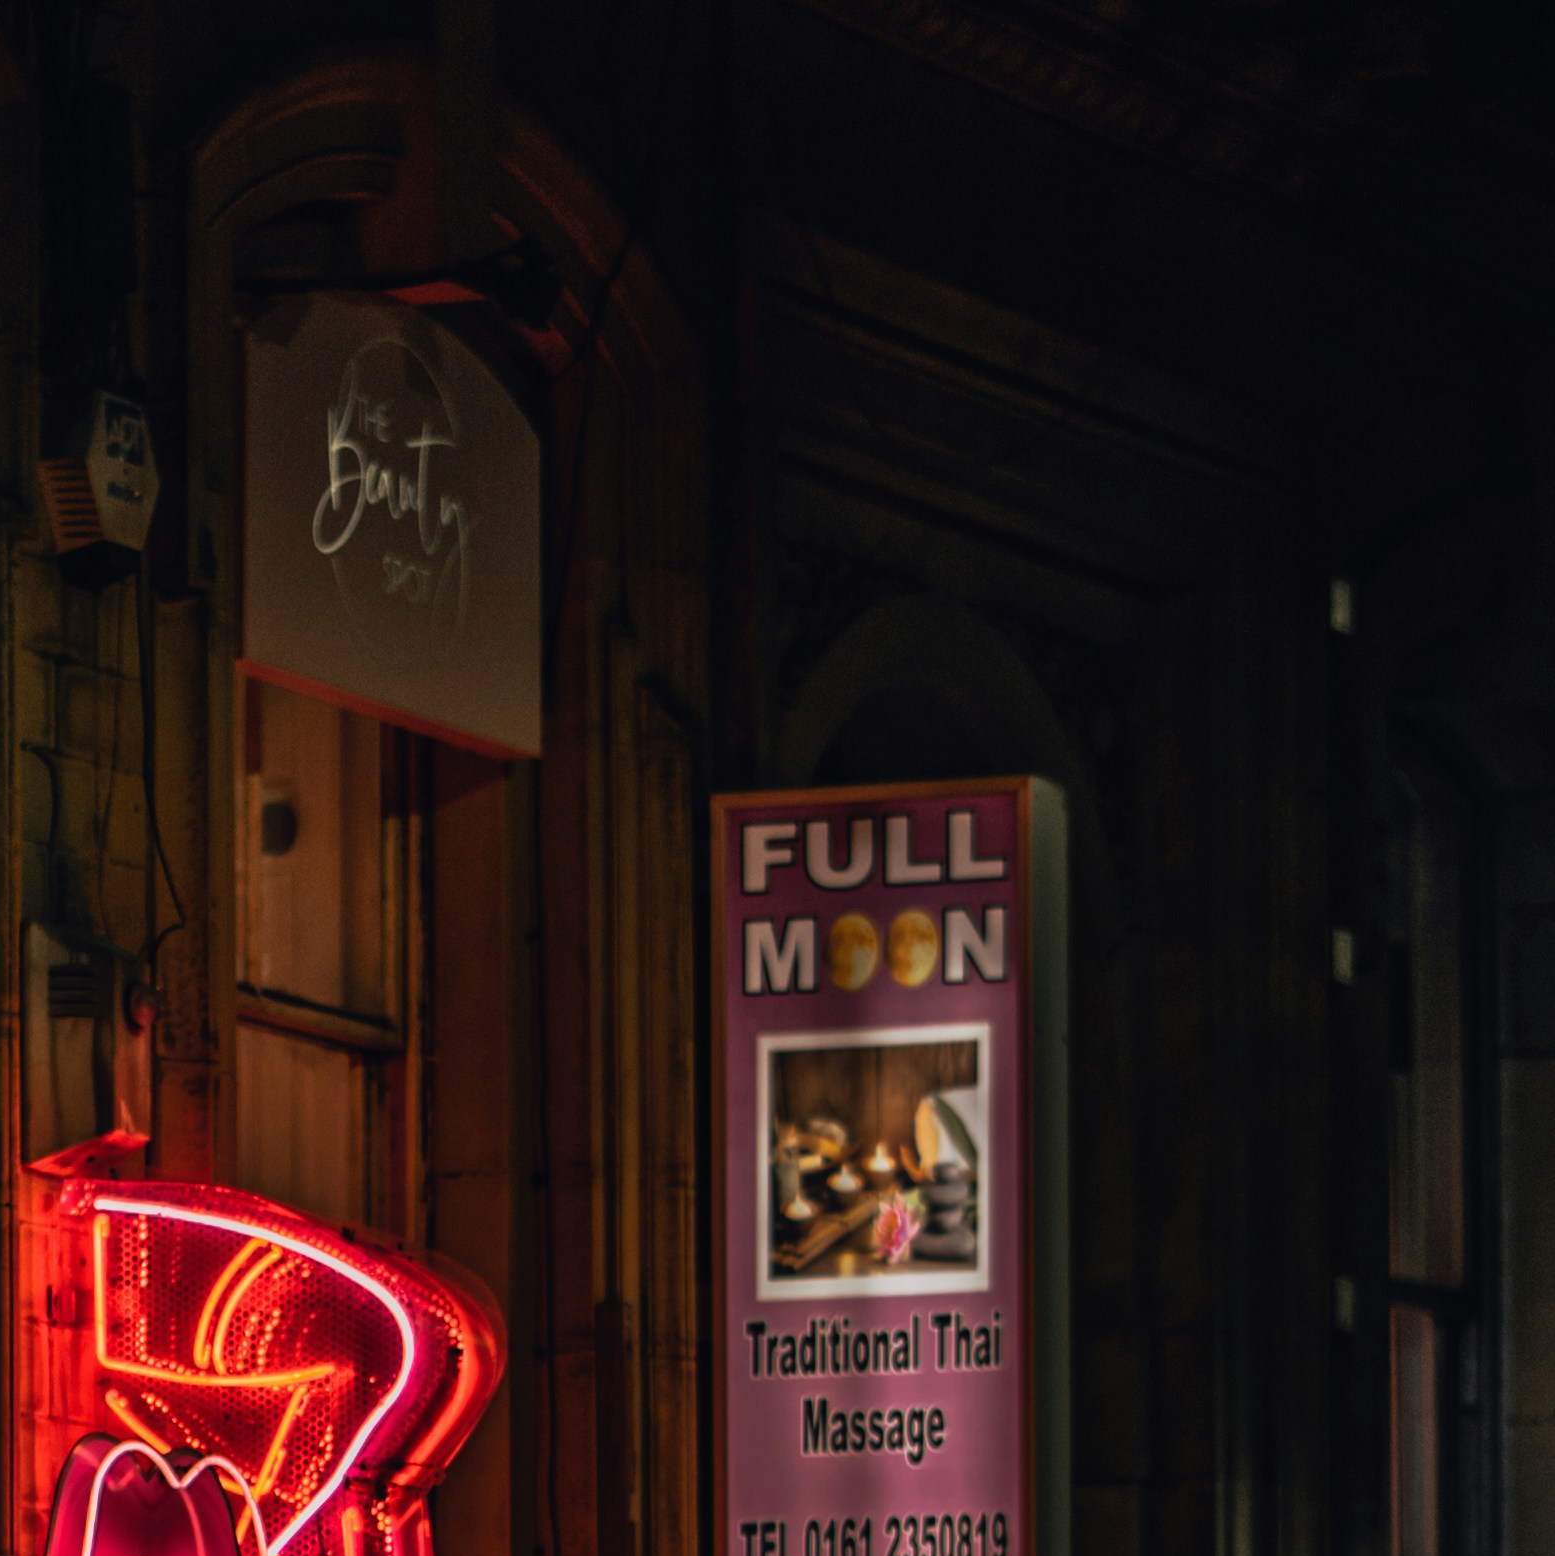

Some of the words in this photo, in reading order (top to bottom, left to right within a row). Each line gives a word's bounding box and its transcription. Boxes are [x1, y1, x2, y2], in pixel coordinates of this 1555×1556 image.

[742, 808, 1008, 895] FULL
[746, 1312, 921, 1378] Traditional
[931, 1309, 1002, 1370] Thai
[802, 1397, 945, 1464] Massage
